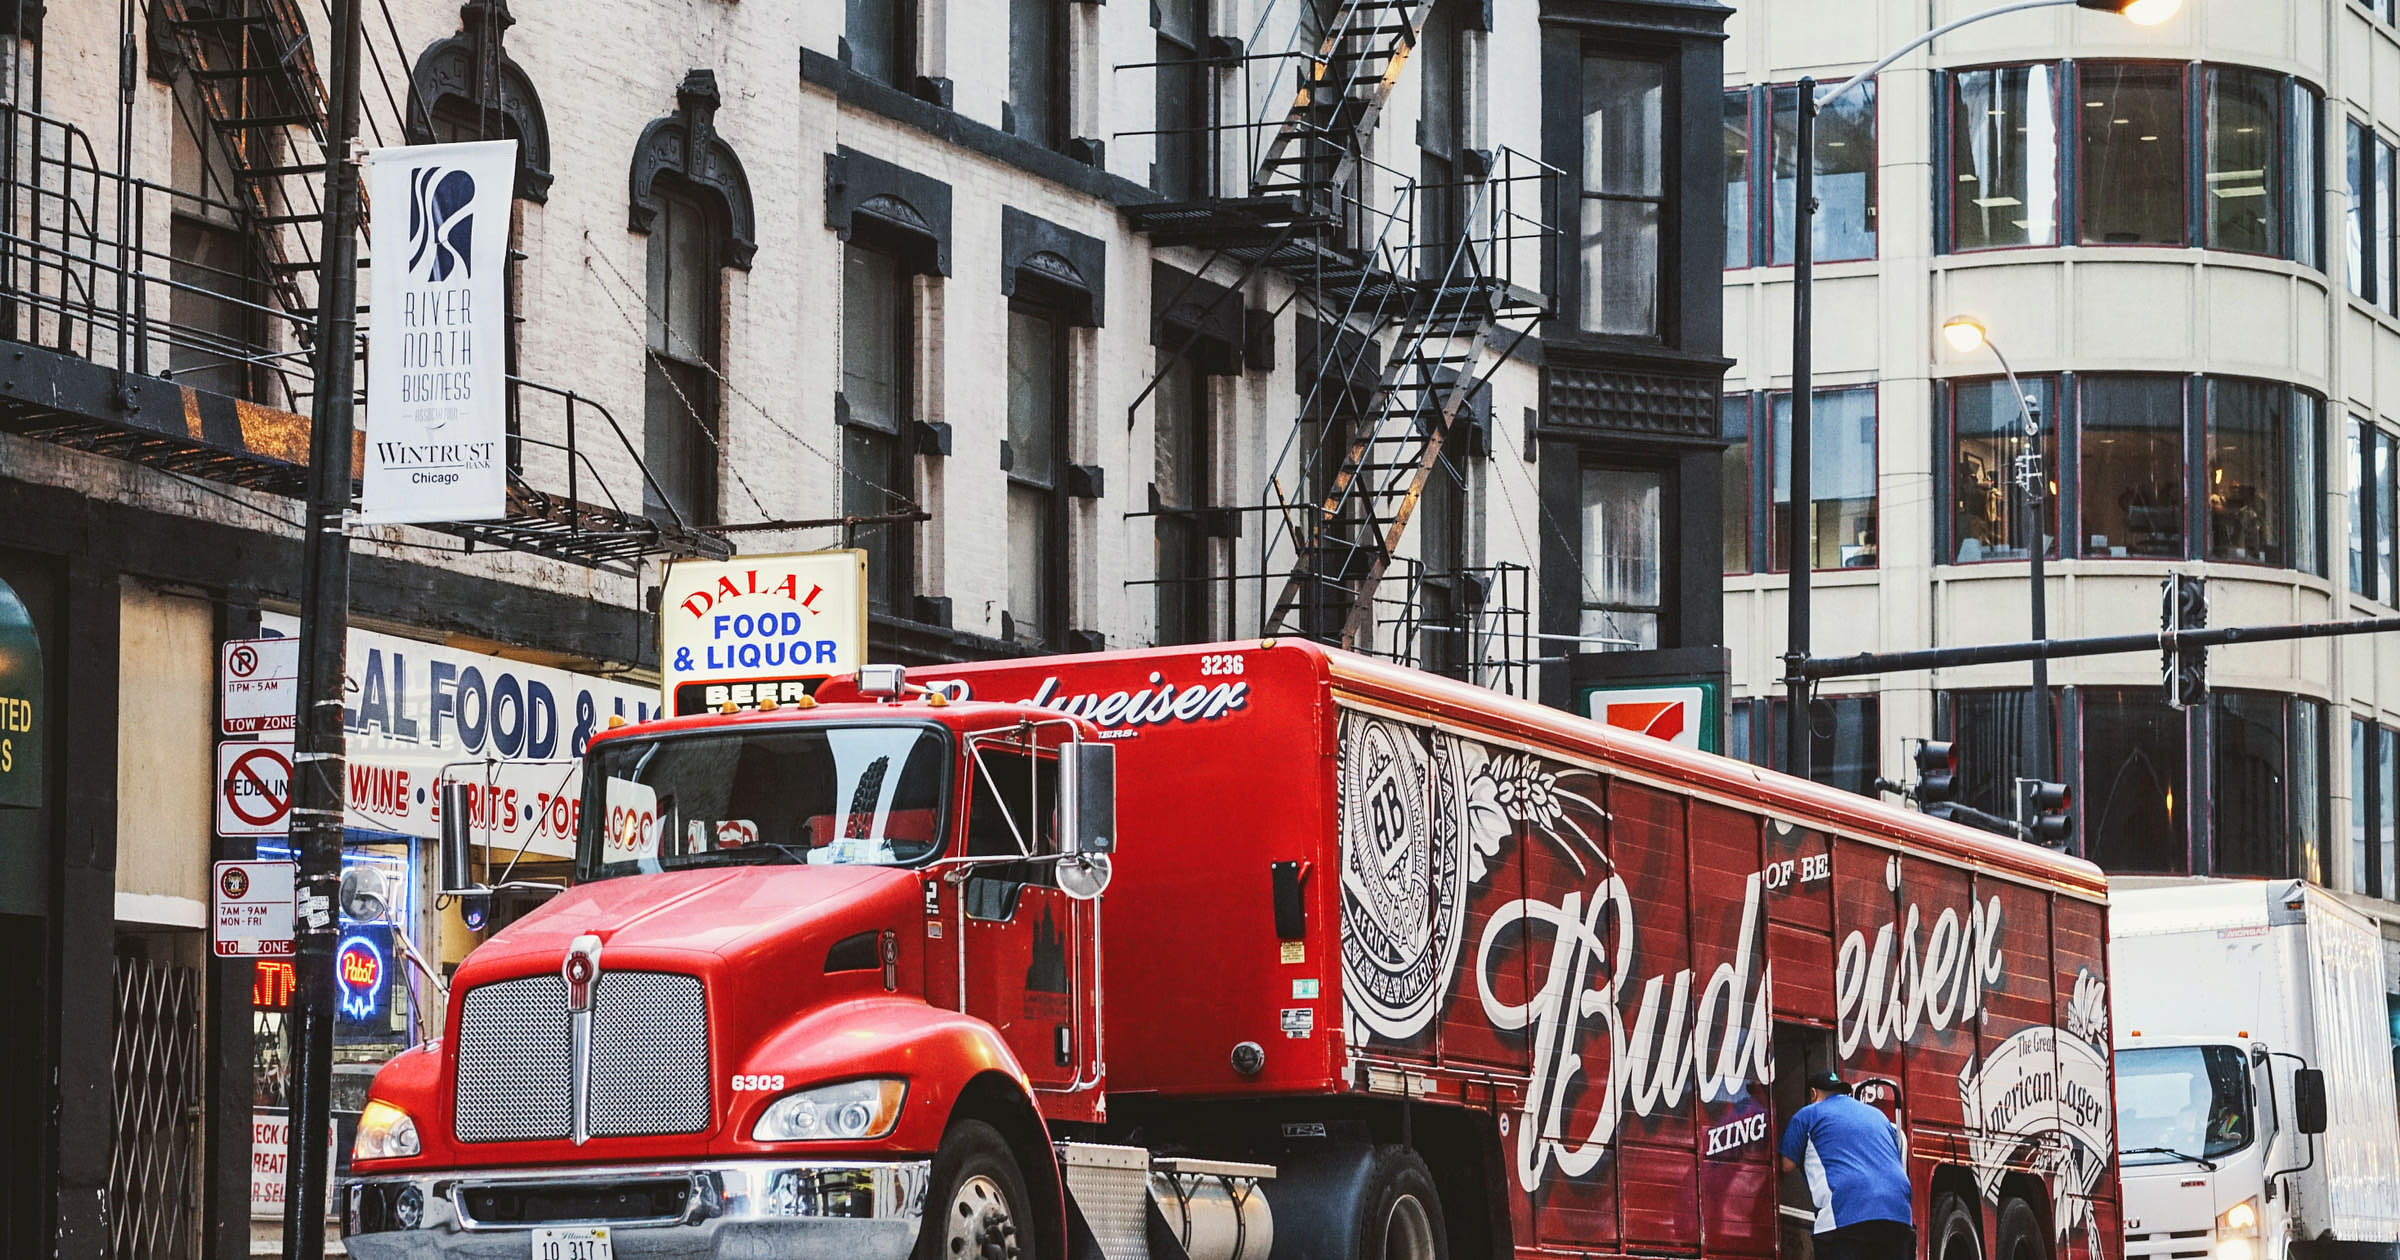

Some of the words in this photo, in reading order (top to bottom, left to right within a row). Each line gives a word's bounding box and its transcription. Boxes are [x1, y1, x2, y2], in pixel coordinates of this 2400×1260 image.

[404, 288, 472, 328] RIVER
[402, 329, 471, 368] NORTH
[402, 371, 471, 402] BUSINESS
[377, 442, 494, 463] WINTRUST
[412, 472, 459, 485] Chicago
[680, 570, 825, 619] DALAL
[714, 612, 801, 639] FOOD
[673, 646, 695, 671] &
[707, 640, 837, 669] LIQUOR
[1201, 655, 1244, 675] 3236
[706, 682, 805, 705] BEER
[229, 719, 256, 731] TOW
[263, 716, 296, 729] ZONE
[430, 660, 559, 761] FOOD
[572, 690, 597, 758] &
[350, 763, 411, 818] WINE
[1766, 859, 1794, 889] OF
[220, 906, 240, 916] 7AM
[247, 906, 267, 915] 9AM
[220, 917, 240, 926] MON
[247, 917, 262, 926] FRI
[257, 941, 289, 953] ZONE
[1353, 906, 1390, 963] AFRICA
[343, 953, 376, 985] Pabst
[2018, 1034, 2032, 1058] The
[732, 1074, 785, 1091] 6303
[2058, 1062, 2103, 1127] Lager
[1706, 1112, 1767, 1156] KING
[543, 1241, 559, 1260] 10
[570, 1241, 594, 1260] 317
[602, 1243, 608, 1256] T
